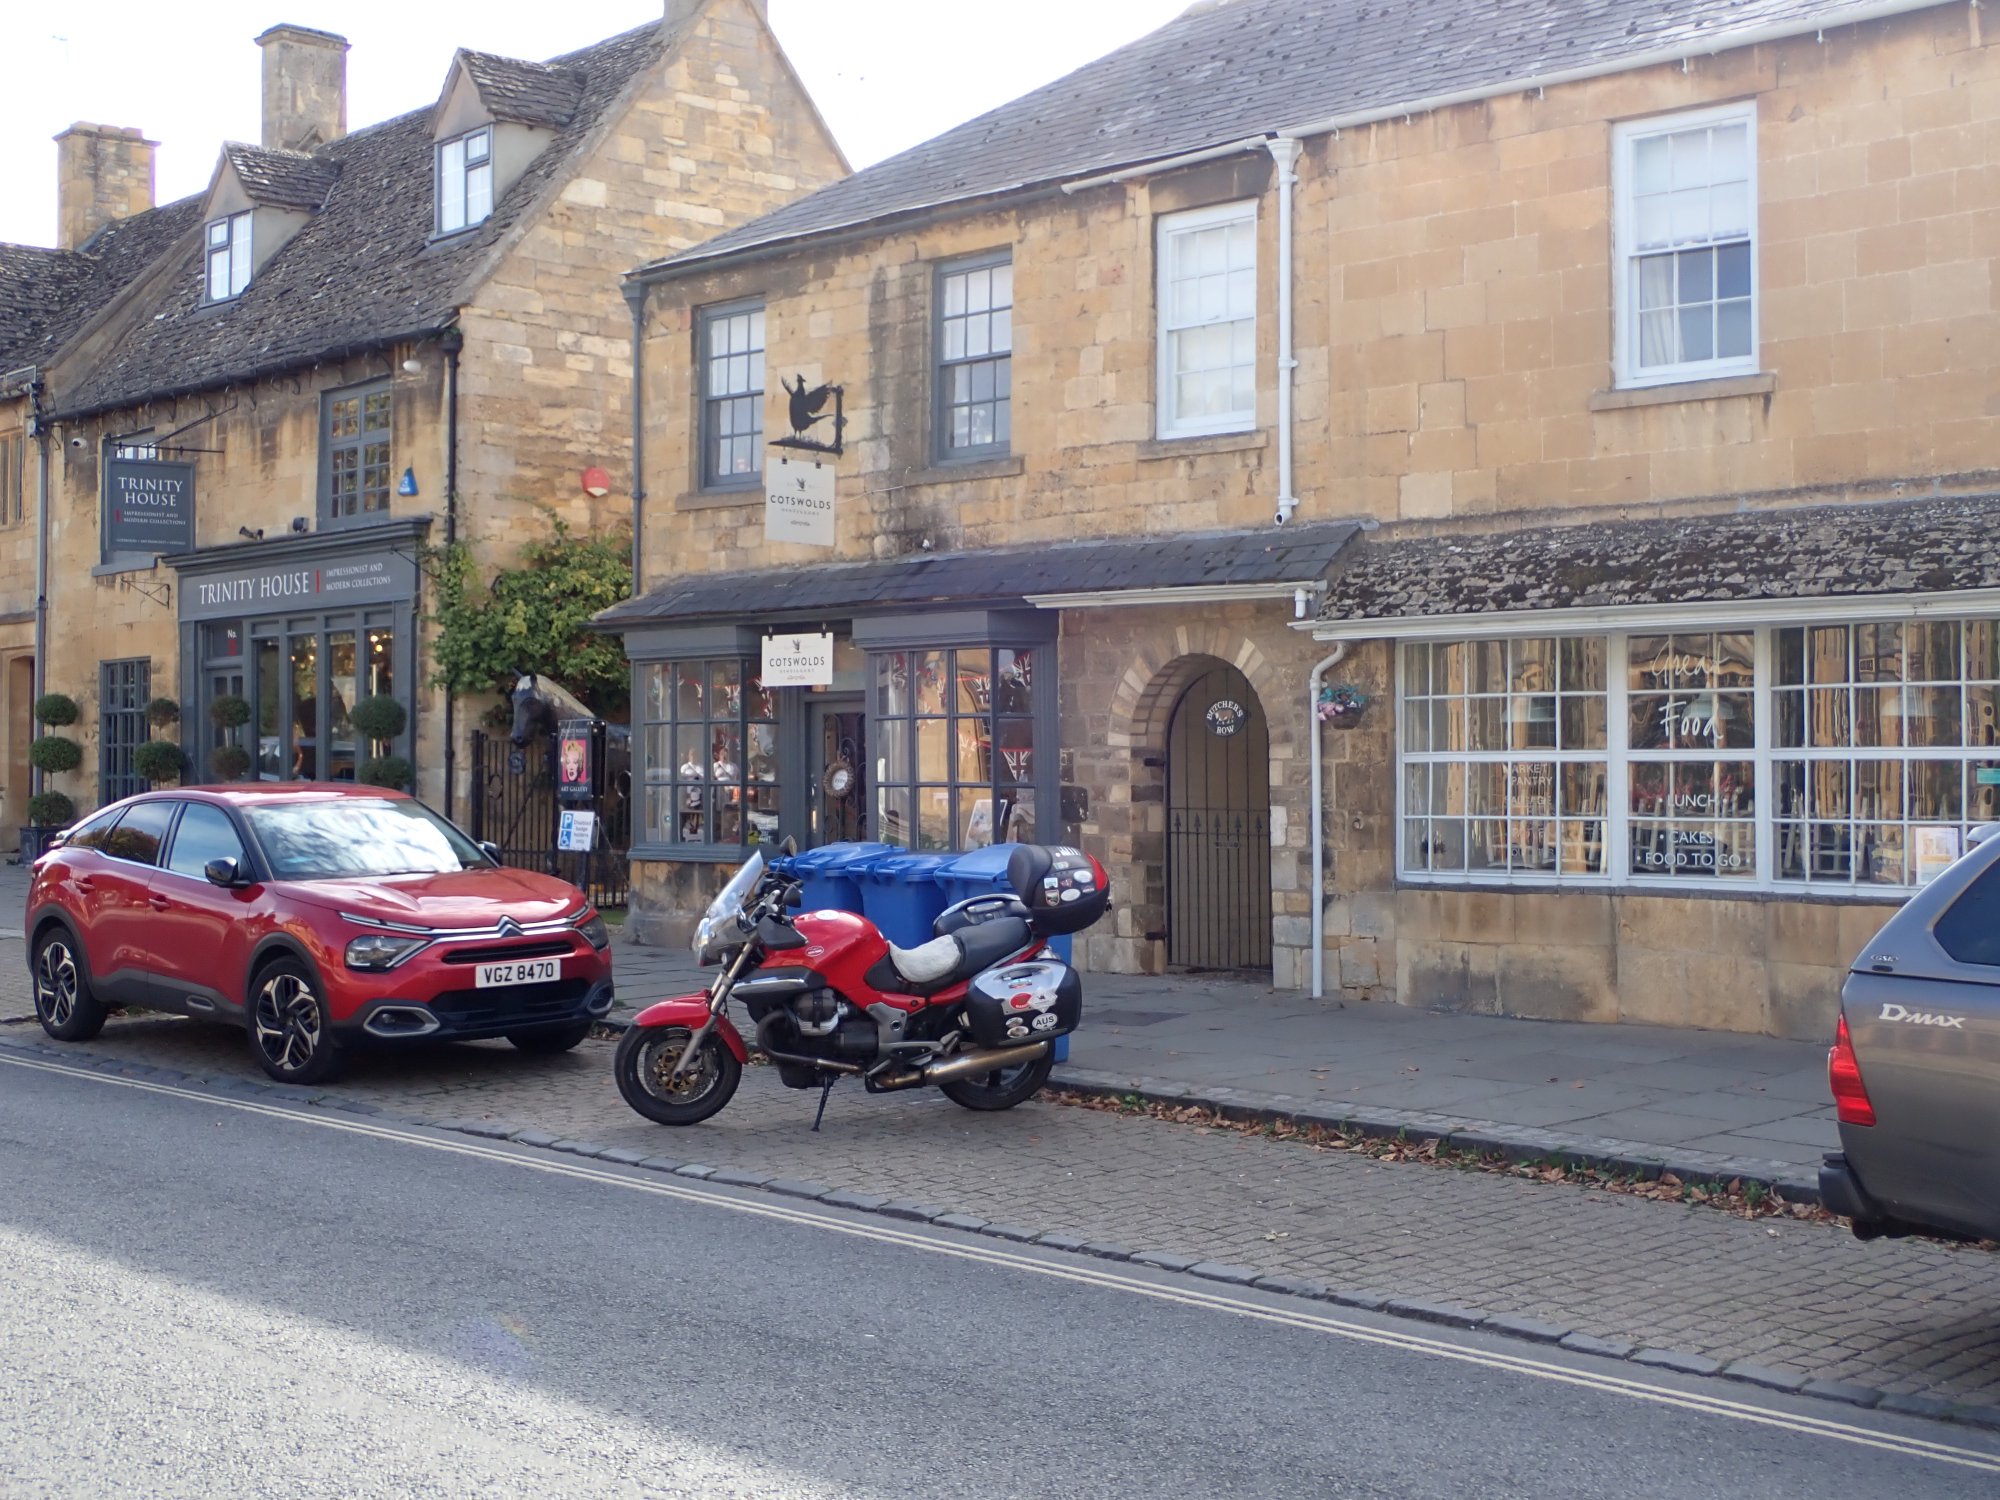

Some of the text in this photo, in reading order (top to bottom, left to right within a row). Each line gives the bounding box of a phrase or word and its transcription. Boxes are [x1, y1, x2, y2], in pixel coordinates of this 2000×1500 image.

[118, 477, 183, 492] TRINITY
[125, 492, 177, 506] HOUSE
[770, 495, 831, 510] COTSWOLDS
[149, 518, 186, 526] COLLECTIONS
[325, 562, 383, 578] IMPRESSIONIST AND
[199, 572, 310, 605] TRINITY HOUSE
[325, 576, 392, 591] MODERN COLLECTIONS
[769, 656, 825, 667] COTSWOLDS
[1651, 640, 1730, 685] Great
[1206, 700, 1243, 720] BUTCHERS
[1658, 701, 1724, 739] Food
[1216, 725, 1235, 734] ROW
[1667, 794, 1717, 807] LUNCH
[1671, 831, 1714, 844] CAKES
[1645, 853, 1741, 867] FOOD TO GO
[484, 962, 554, 983] VGZ 8470
[1036, 1016, 1055, 1026] AUS
